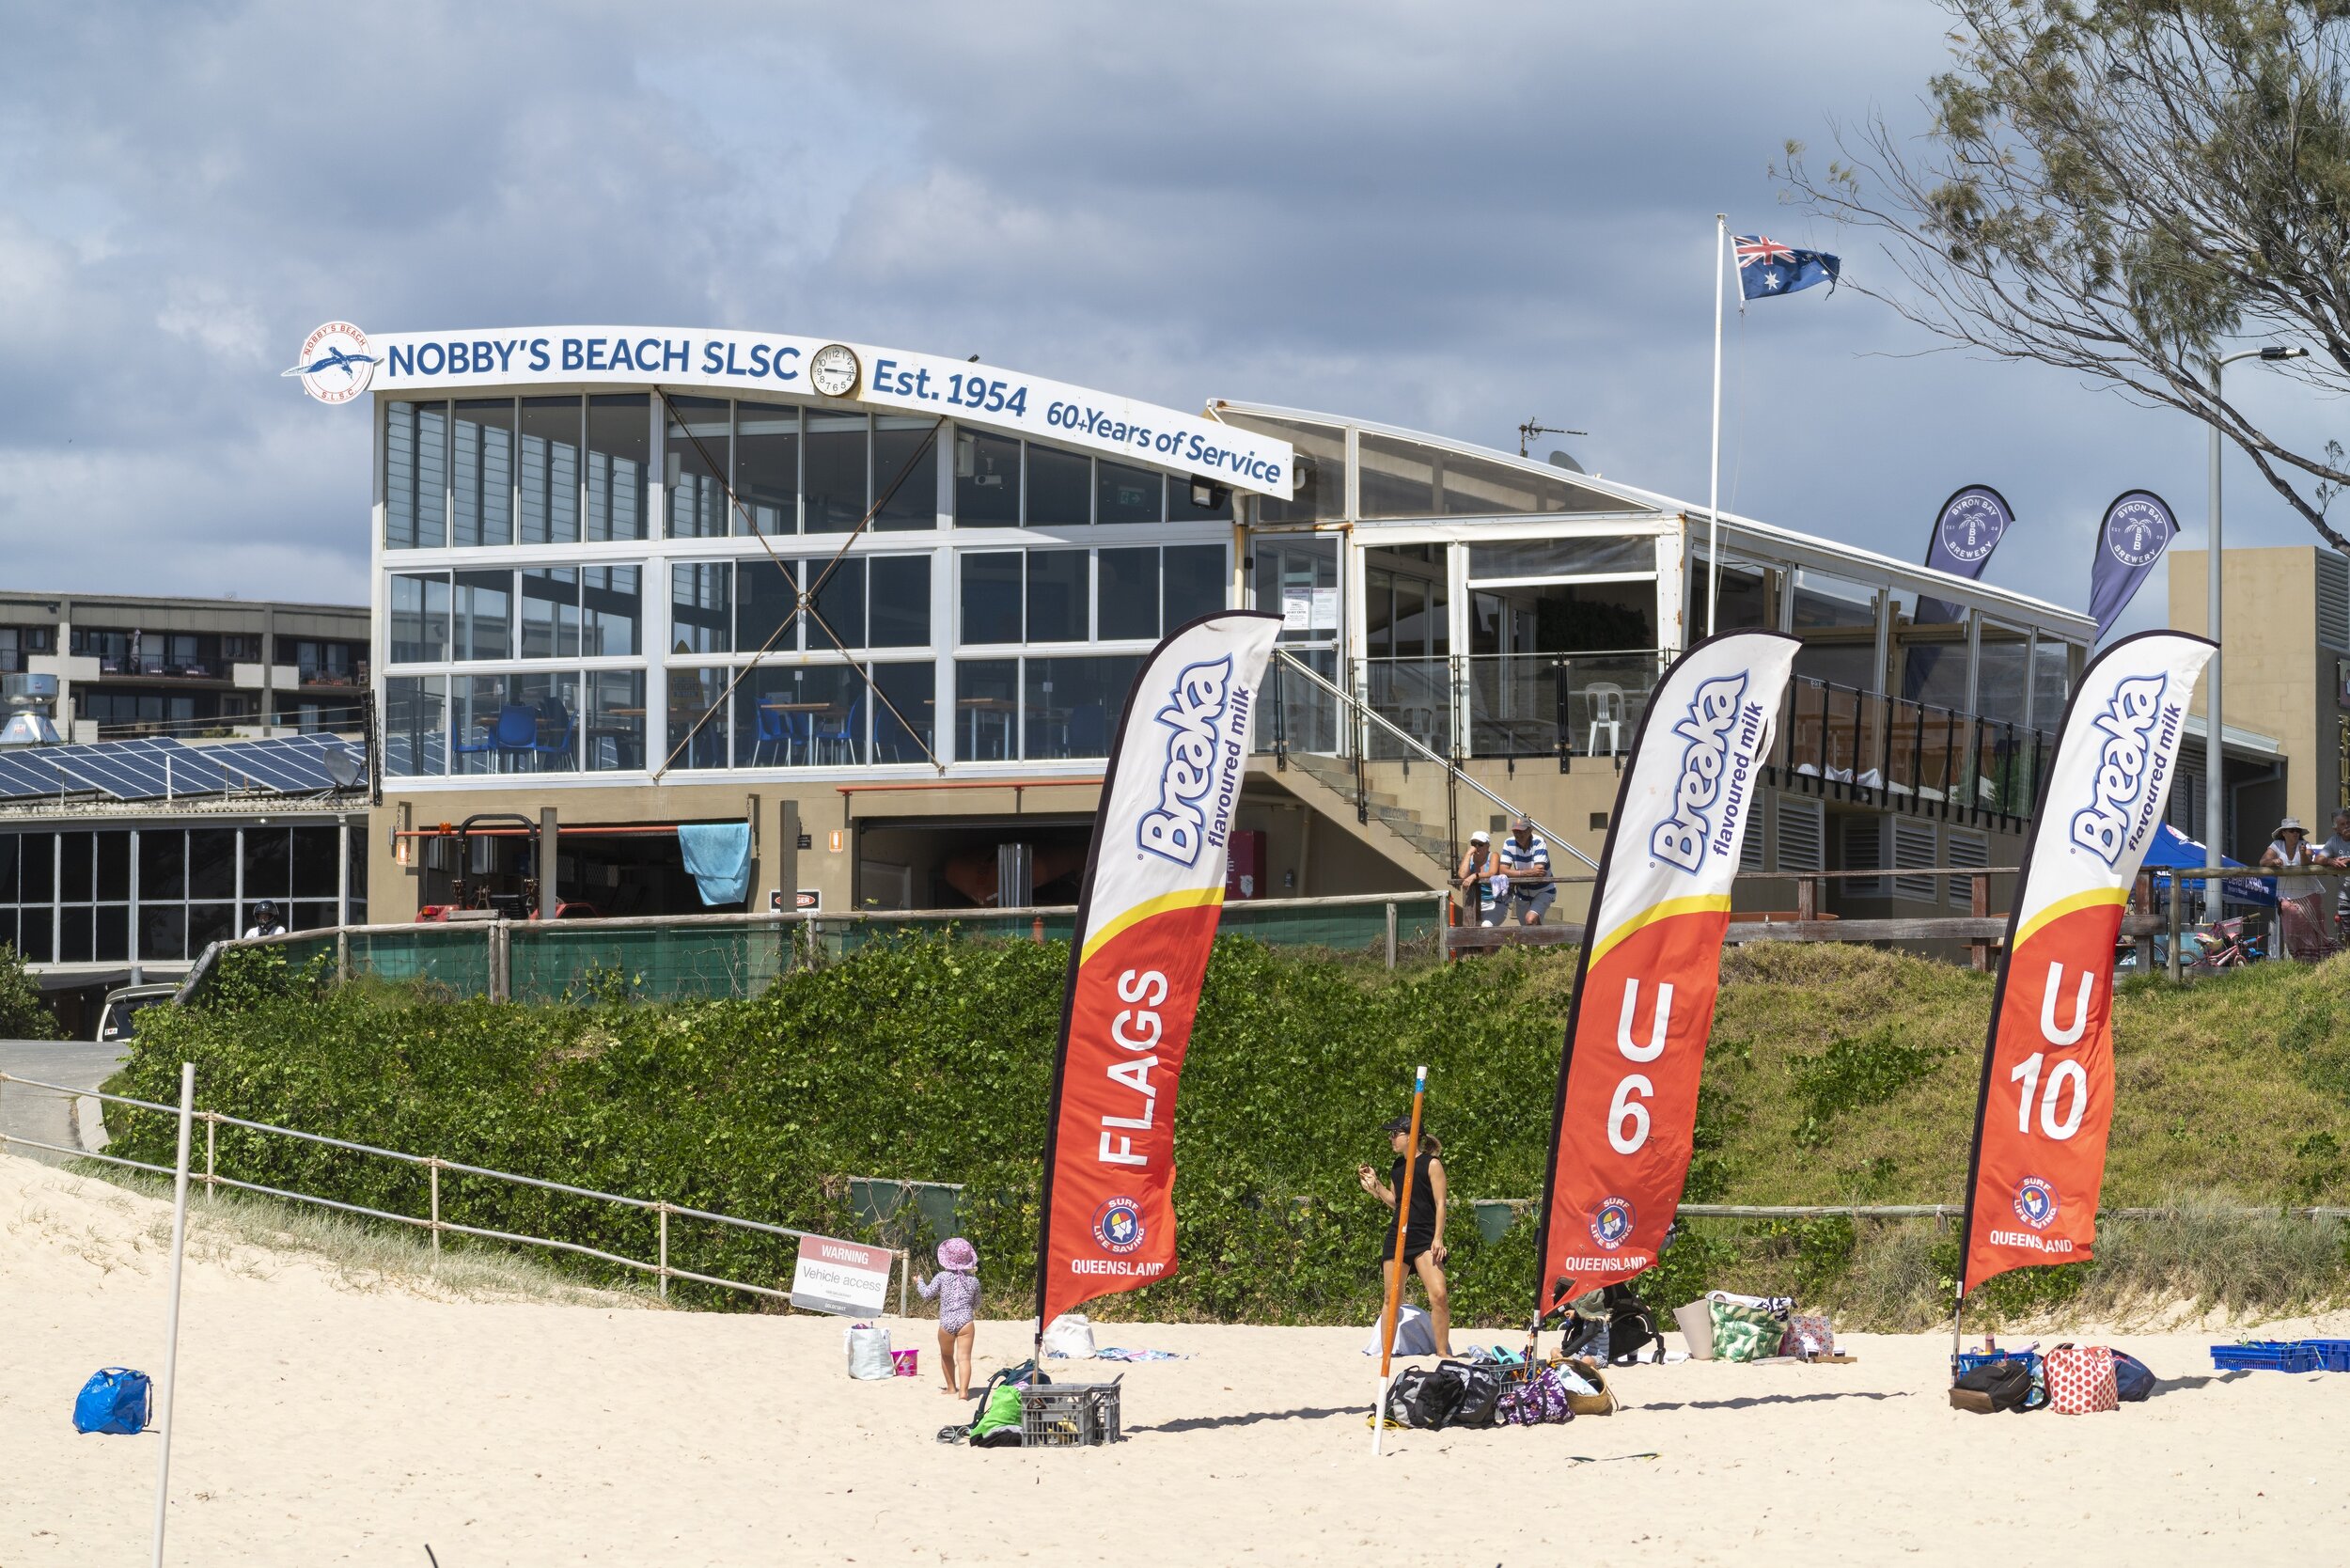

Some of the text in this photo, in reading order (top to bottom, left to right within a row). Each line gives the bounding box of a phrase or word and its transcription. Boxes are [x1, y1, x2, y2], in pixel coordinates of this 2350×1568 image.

[304, 324, 367, 355] NOBBY'S BEACH
[389, 338, 801, 381] NOBBY'S BEACH SLSC
[873, 359, 1027, 417] Est. 1954
[1155, 431, 1187, 455] of
[1185, 434, 1281, 483] Service
[1951, 498, 1998, 516] BYRON BAY
[2117, 504, 2163, 525] BYRON BAY
[1949, 541, 1992, 558] BREWERY
[2114, 544, 2155, 563] BREWERY
[1136, 652, 1233, 870] Breaka
[1208, 685, 1249, 849] flavoured milk
[1649, 667, 1749, 876] Breaka
[2070, 670, 2168, 869] Breaka
[1713, 701, 1762, 856] flavoured milk
[2128, 751, 2167, 852] flavoured
[2159, 702, 2181, 750] milk
[1380, 805, 1410, 821] WELCOME
[2041, 961, 2094, 1045] U
[1617, 978, 1673, 1062] U
[1099, 969, 1167, 1166] FLAGS
[2011, 1052, 2087, 1140] 10
[1607, 1074, 1653, 1154] 6
[2023, 1178, 2051, 1191] SURF
[1108, 1198, 1139, 1211] SURF
[1603, 1198, 1630, 1209] SURF
[2014, 1200, 2057, 1230] LIFE SVING
[1093, 1225, 1145, 1253] LIFE SAVING
[1590, 1224, 1634, 1249] LIFE SAVING
[822, 1244, 870, 1265] WARNING
[1072, 1259, 1165, 1277] QUEENSLAND
[1565, 1256, 1647, 1272] QUEENSLAND
[803, 1265, 882, 1293] Vehicle access
